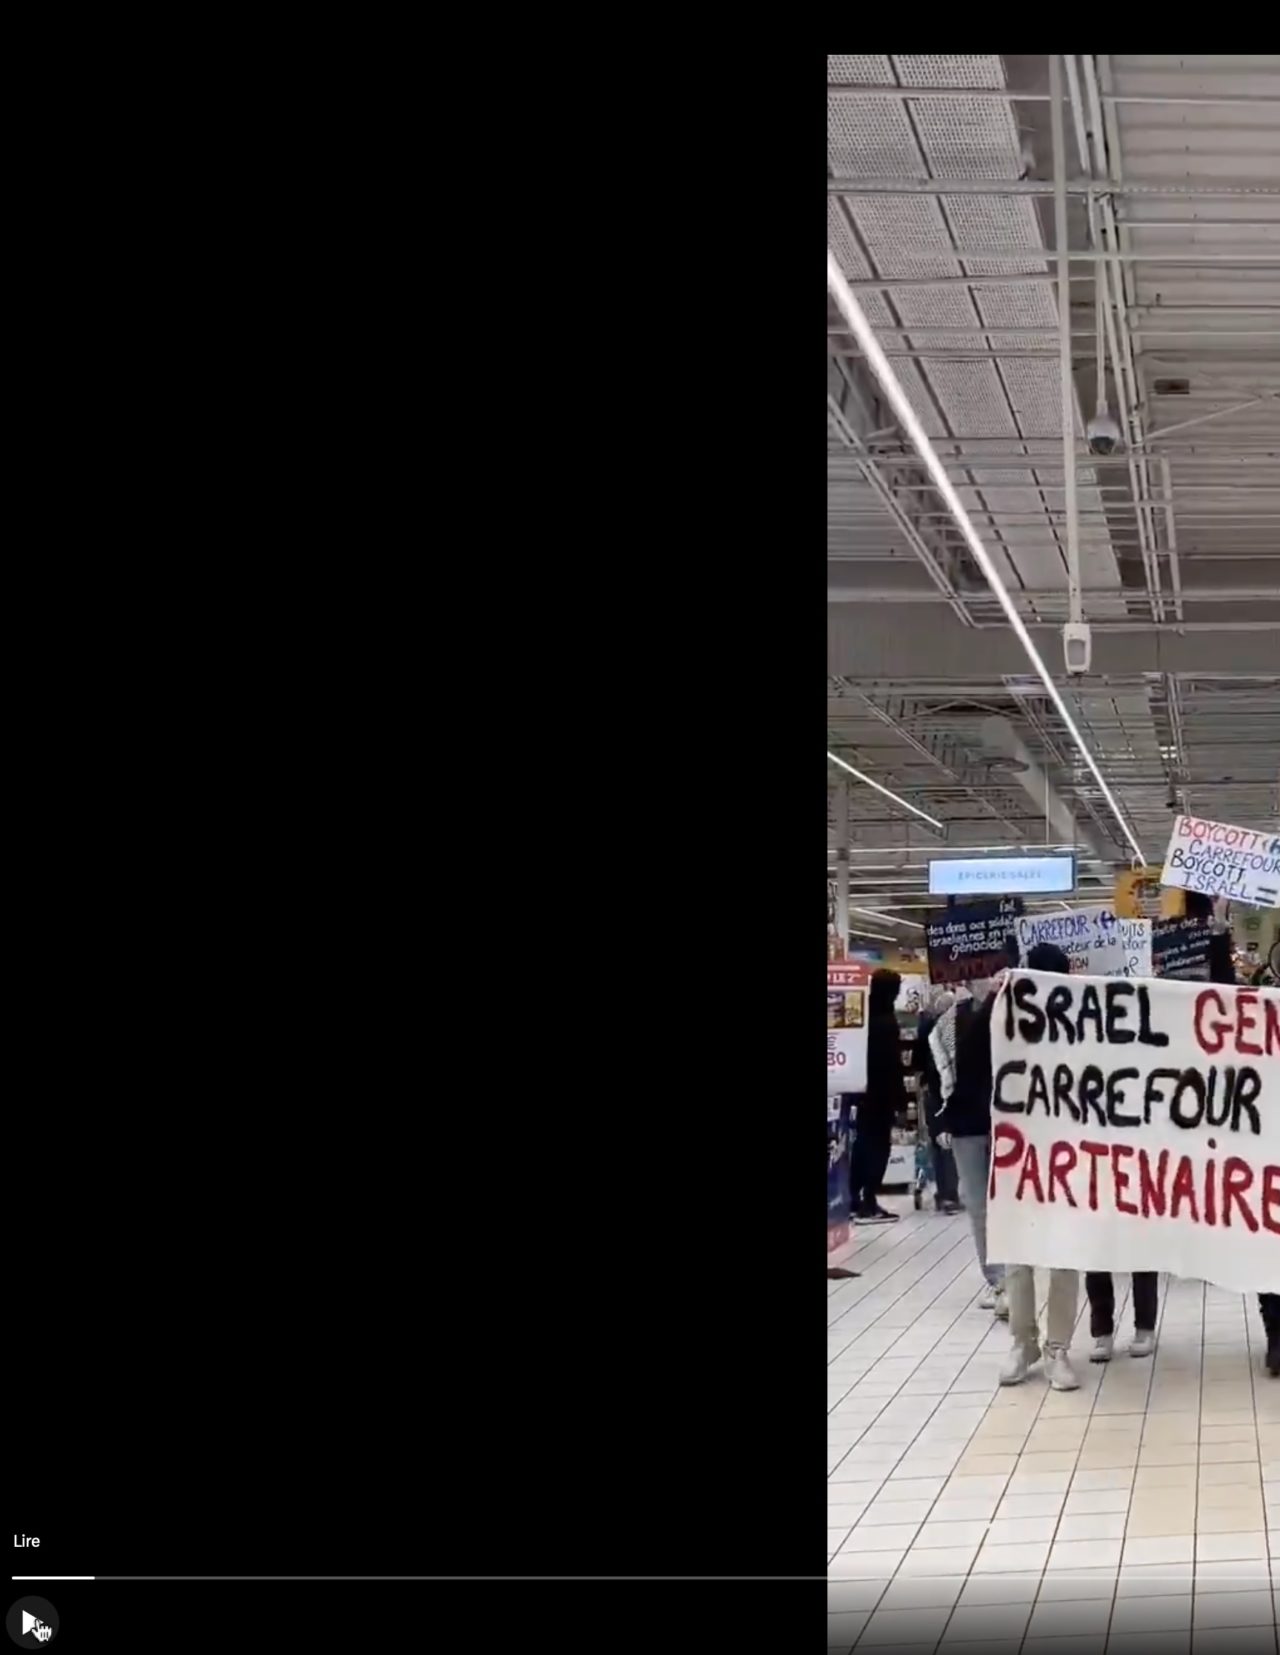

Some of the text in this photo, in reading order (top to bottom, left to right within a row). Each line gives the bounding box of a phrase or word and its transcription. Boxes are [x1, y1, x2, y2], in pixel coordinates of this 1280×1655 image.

[1178, 817, 1262, 850] BOYCOTT
[1170, 848, 1247, 883] BOYCOTT
[1182, 871, 1253, 899] ISRAEL
[1020, 915, 1090, 945] CARREFOUR
[1004, 978, 1169, 1047] ISRAEL
[994, 1060, 1262, 1135] CARREFOUR
